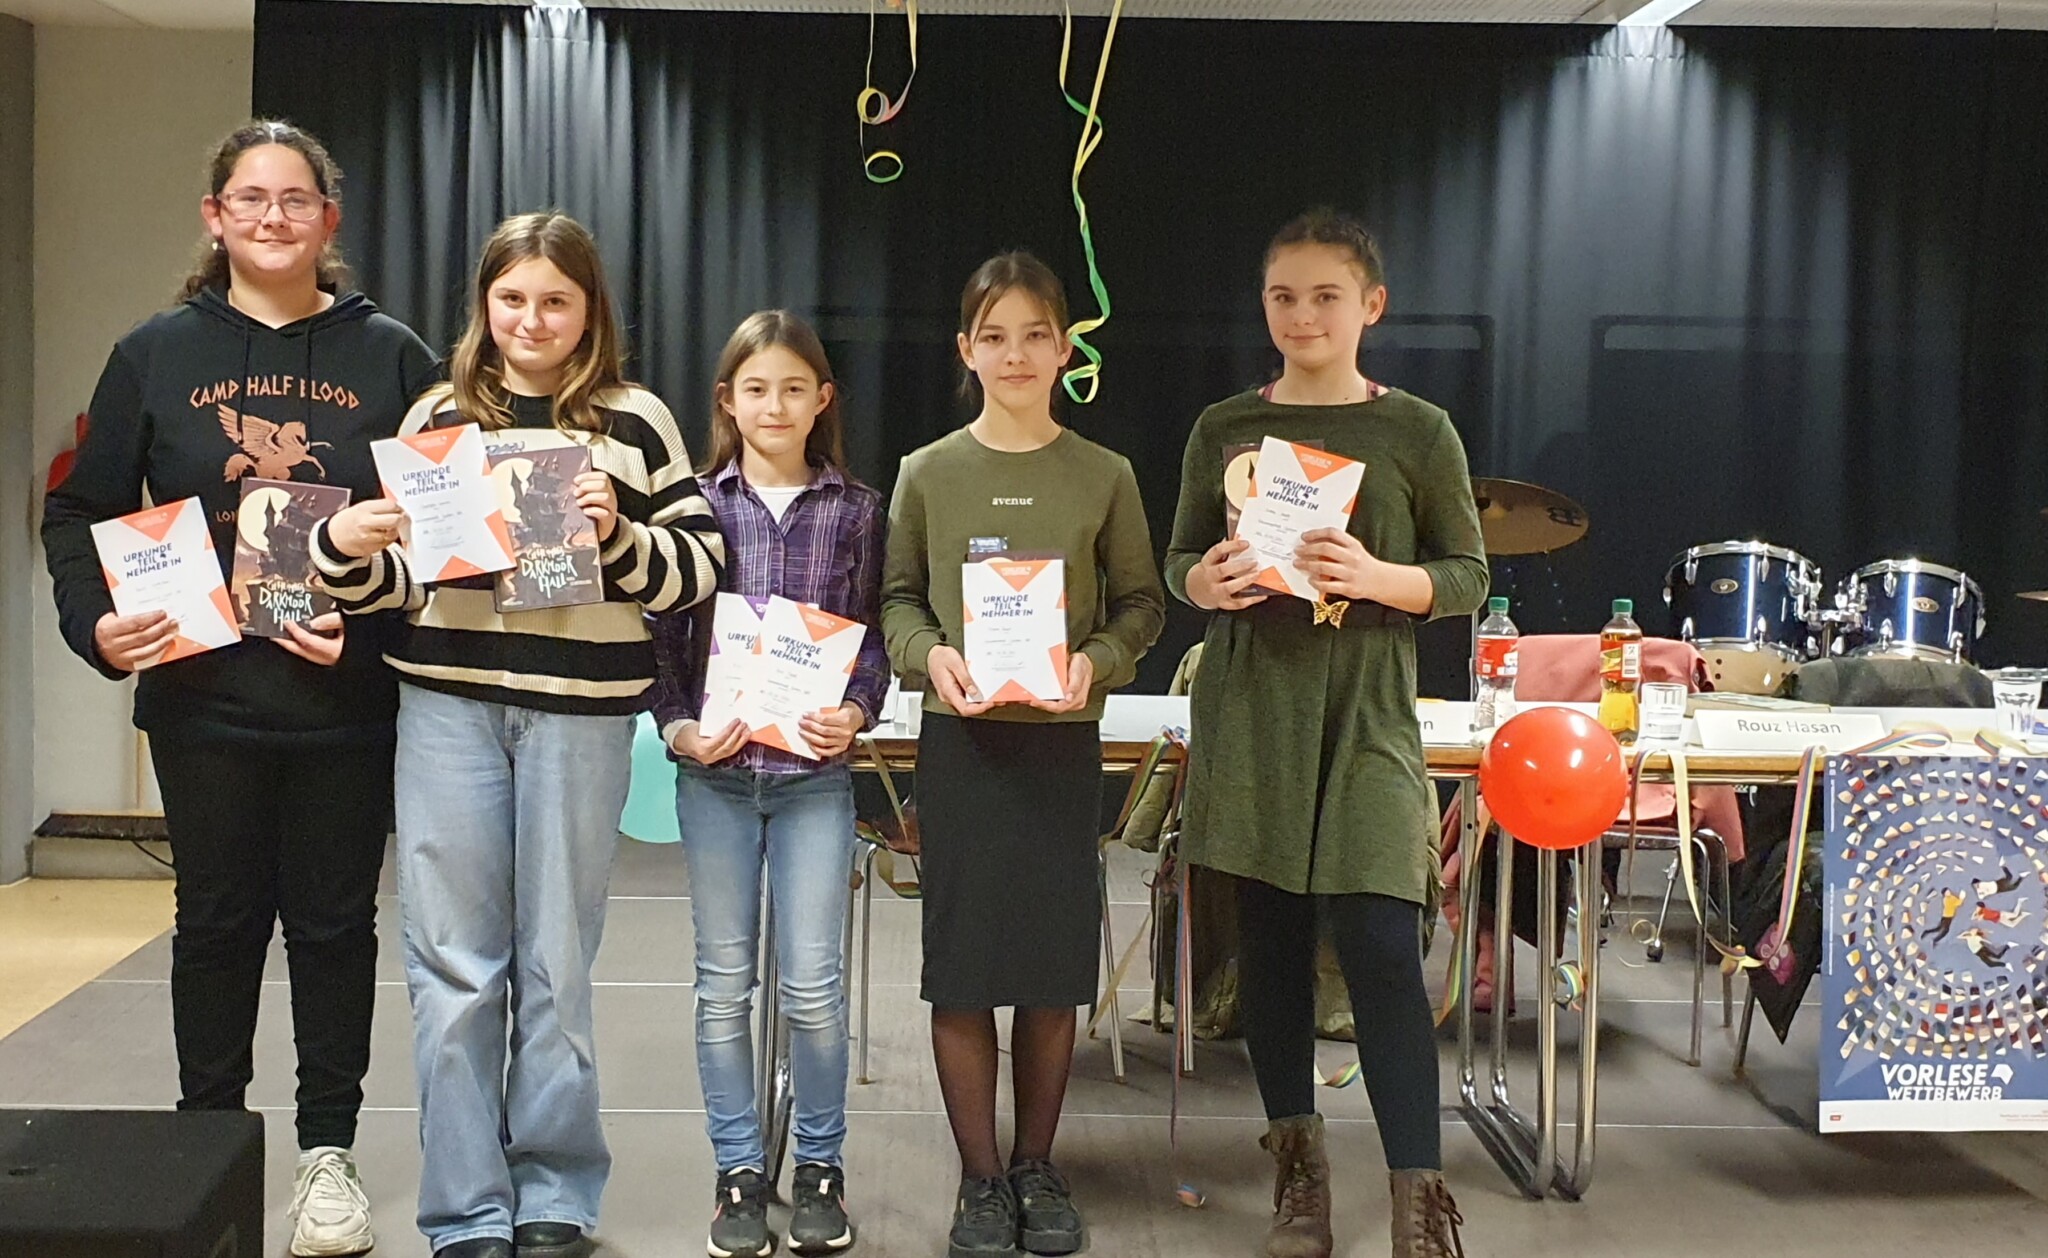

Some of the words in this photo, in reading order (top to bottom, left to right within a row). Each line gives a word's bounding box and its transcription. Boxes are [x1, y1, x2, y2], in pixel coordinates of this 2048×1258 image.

[189, 379, 240, 408] CAMP
[246, 374, 294, 396] HALF
[402, 465, 451, 481] URKUNDE
[1272, 475, 1319, 495] URKUNDE
[991, 497, 1034, 506] avenue
[123, 542, 173, 563] URKUNDE
[983, 594, 1029, 603] URKUNDE
[777, 634, 822, 655] URKUNDE
[1737, 719, 1782, 732] Rouz
[1785, 720, 1841, 733] Hasan
[1880, 1063, 1989, 1086] VORLESE
[1886, 1086, 2003, 1101] WETTBEWERB
